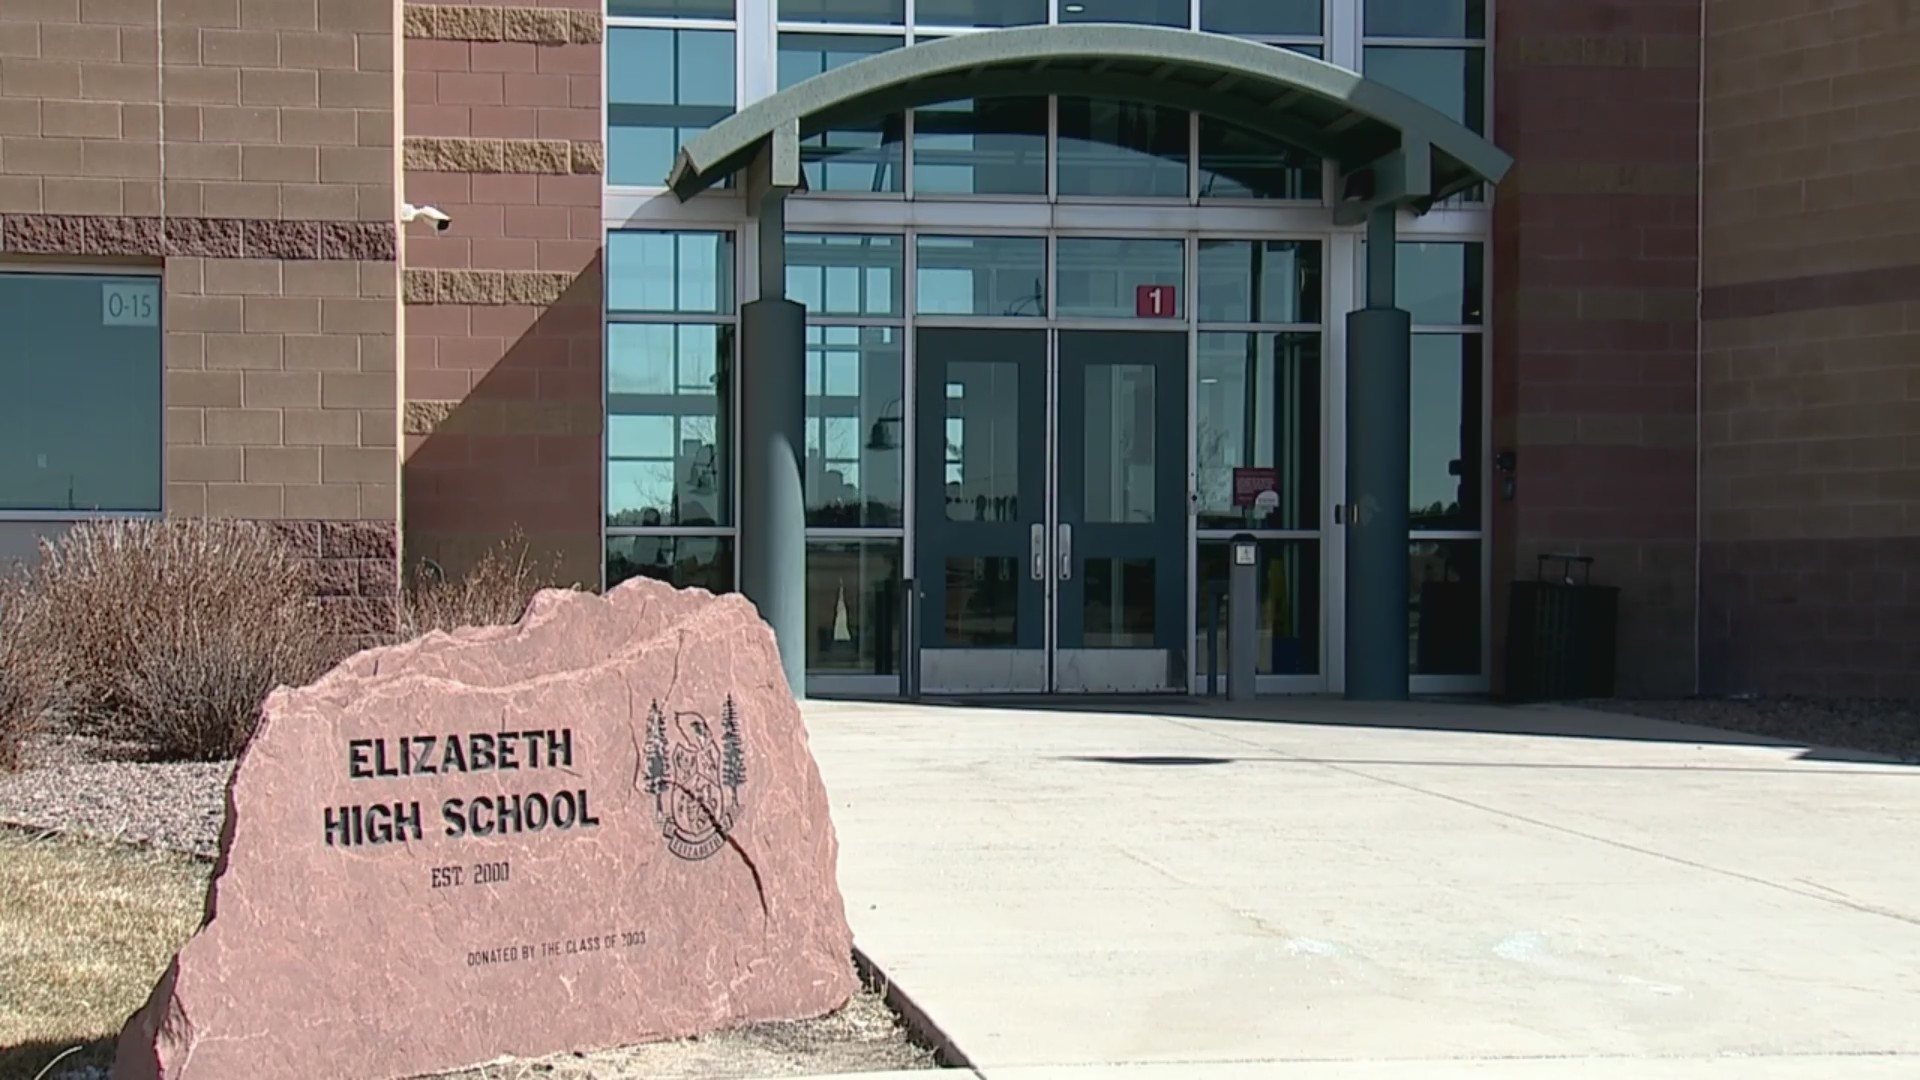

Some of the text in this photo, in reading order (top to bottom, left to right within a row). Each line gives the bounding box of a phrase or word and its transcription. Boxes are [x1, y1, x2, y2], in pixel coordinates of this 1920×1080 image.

[1149, 287, 1161, 314] 1
[349, 728, 573, 779] ELIZABETH
[324, 789, 599, 846] HIGH SCHOOL
[431, 862, 509, 888] EST. 2000
[467, 930, 646, 966] DONATED BY THE CLASS OF 2003
